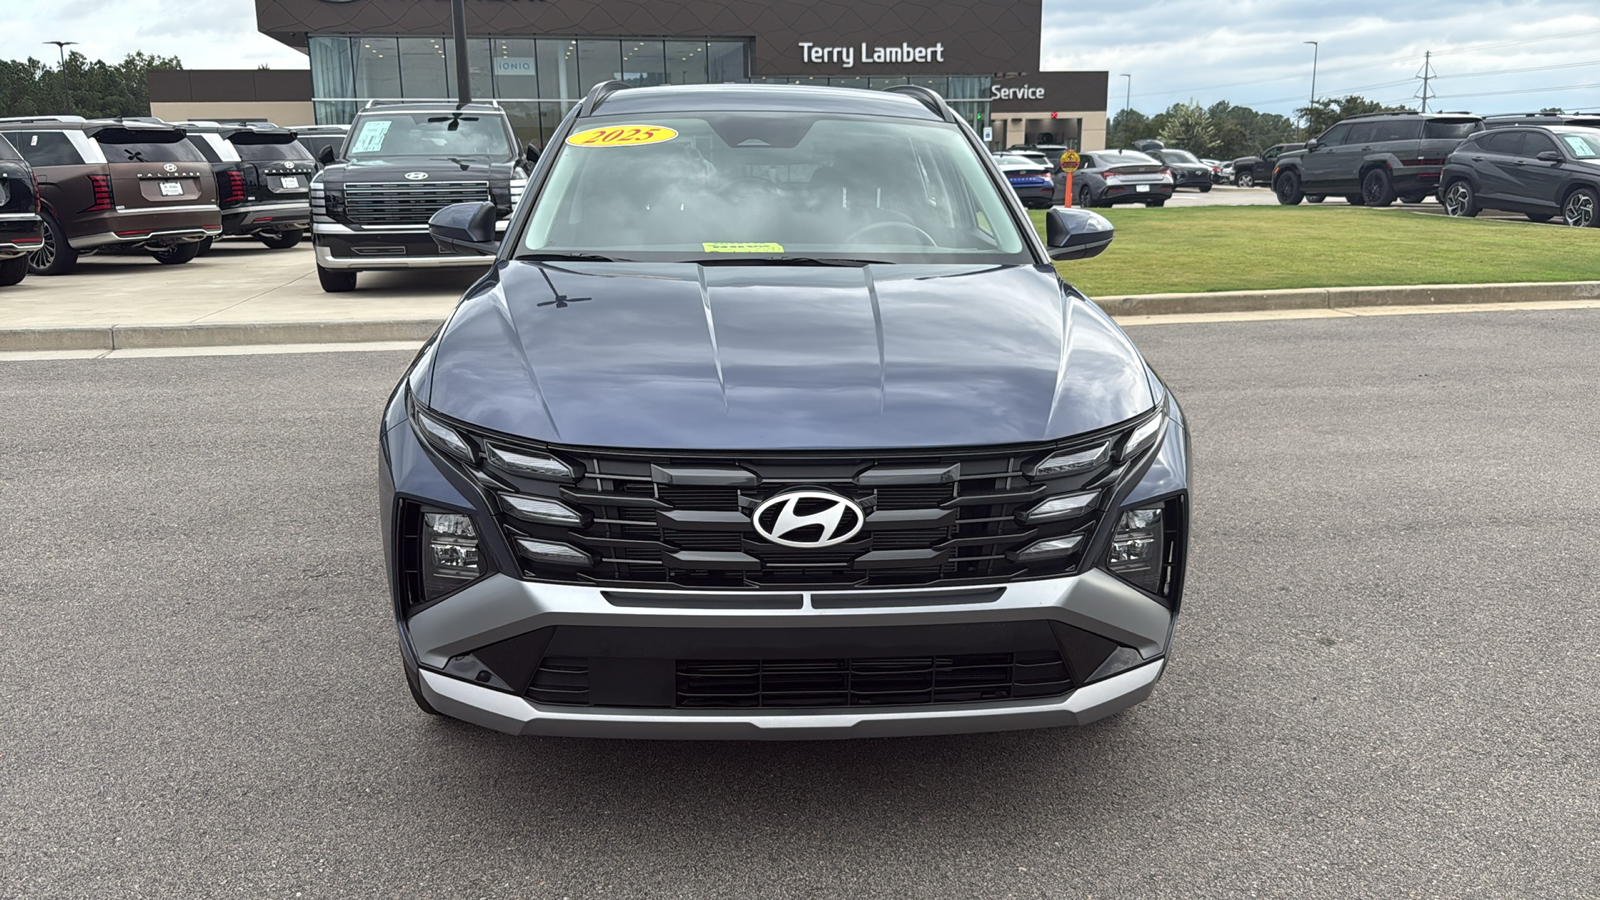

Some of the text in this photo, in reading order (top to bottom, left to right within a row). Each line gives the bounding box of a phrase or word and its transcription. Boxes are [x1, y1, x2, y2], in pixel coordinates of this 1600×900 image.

[798, 42, 945, 68] Terry Lambert
[498, 62, 530, 70] IONIQ
[991, 84, 1045, 100] Service
[582, 128, 662, 144] 2025
